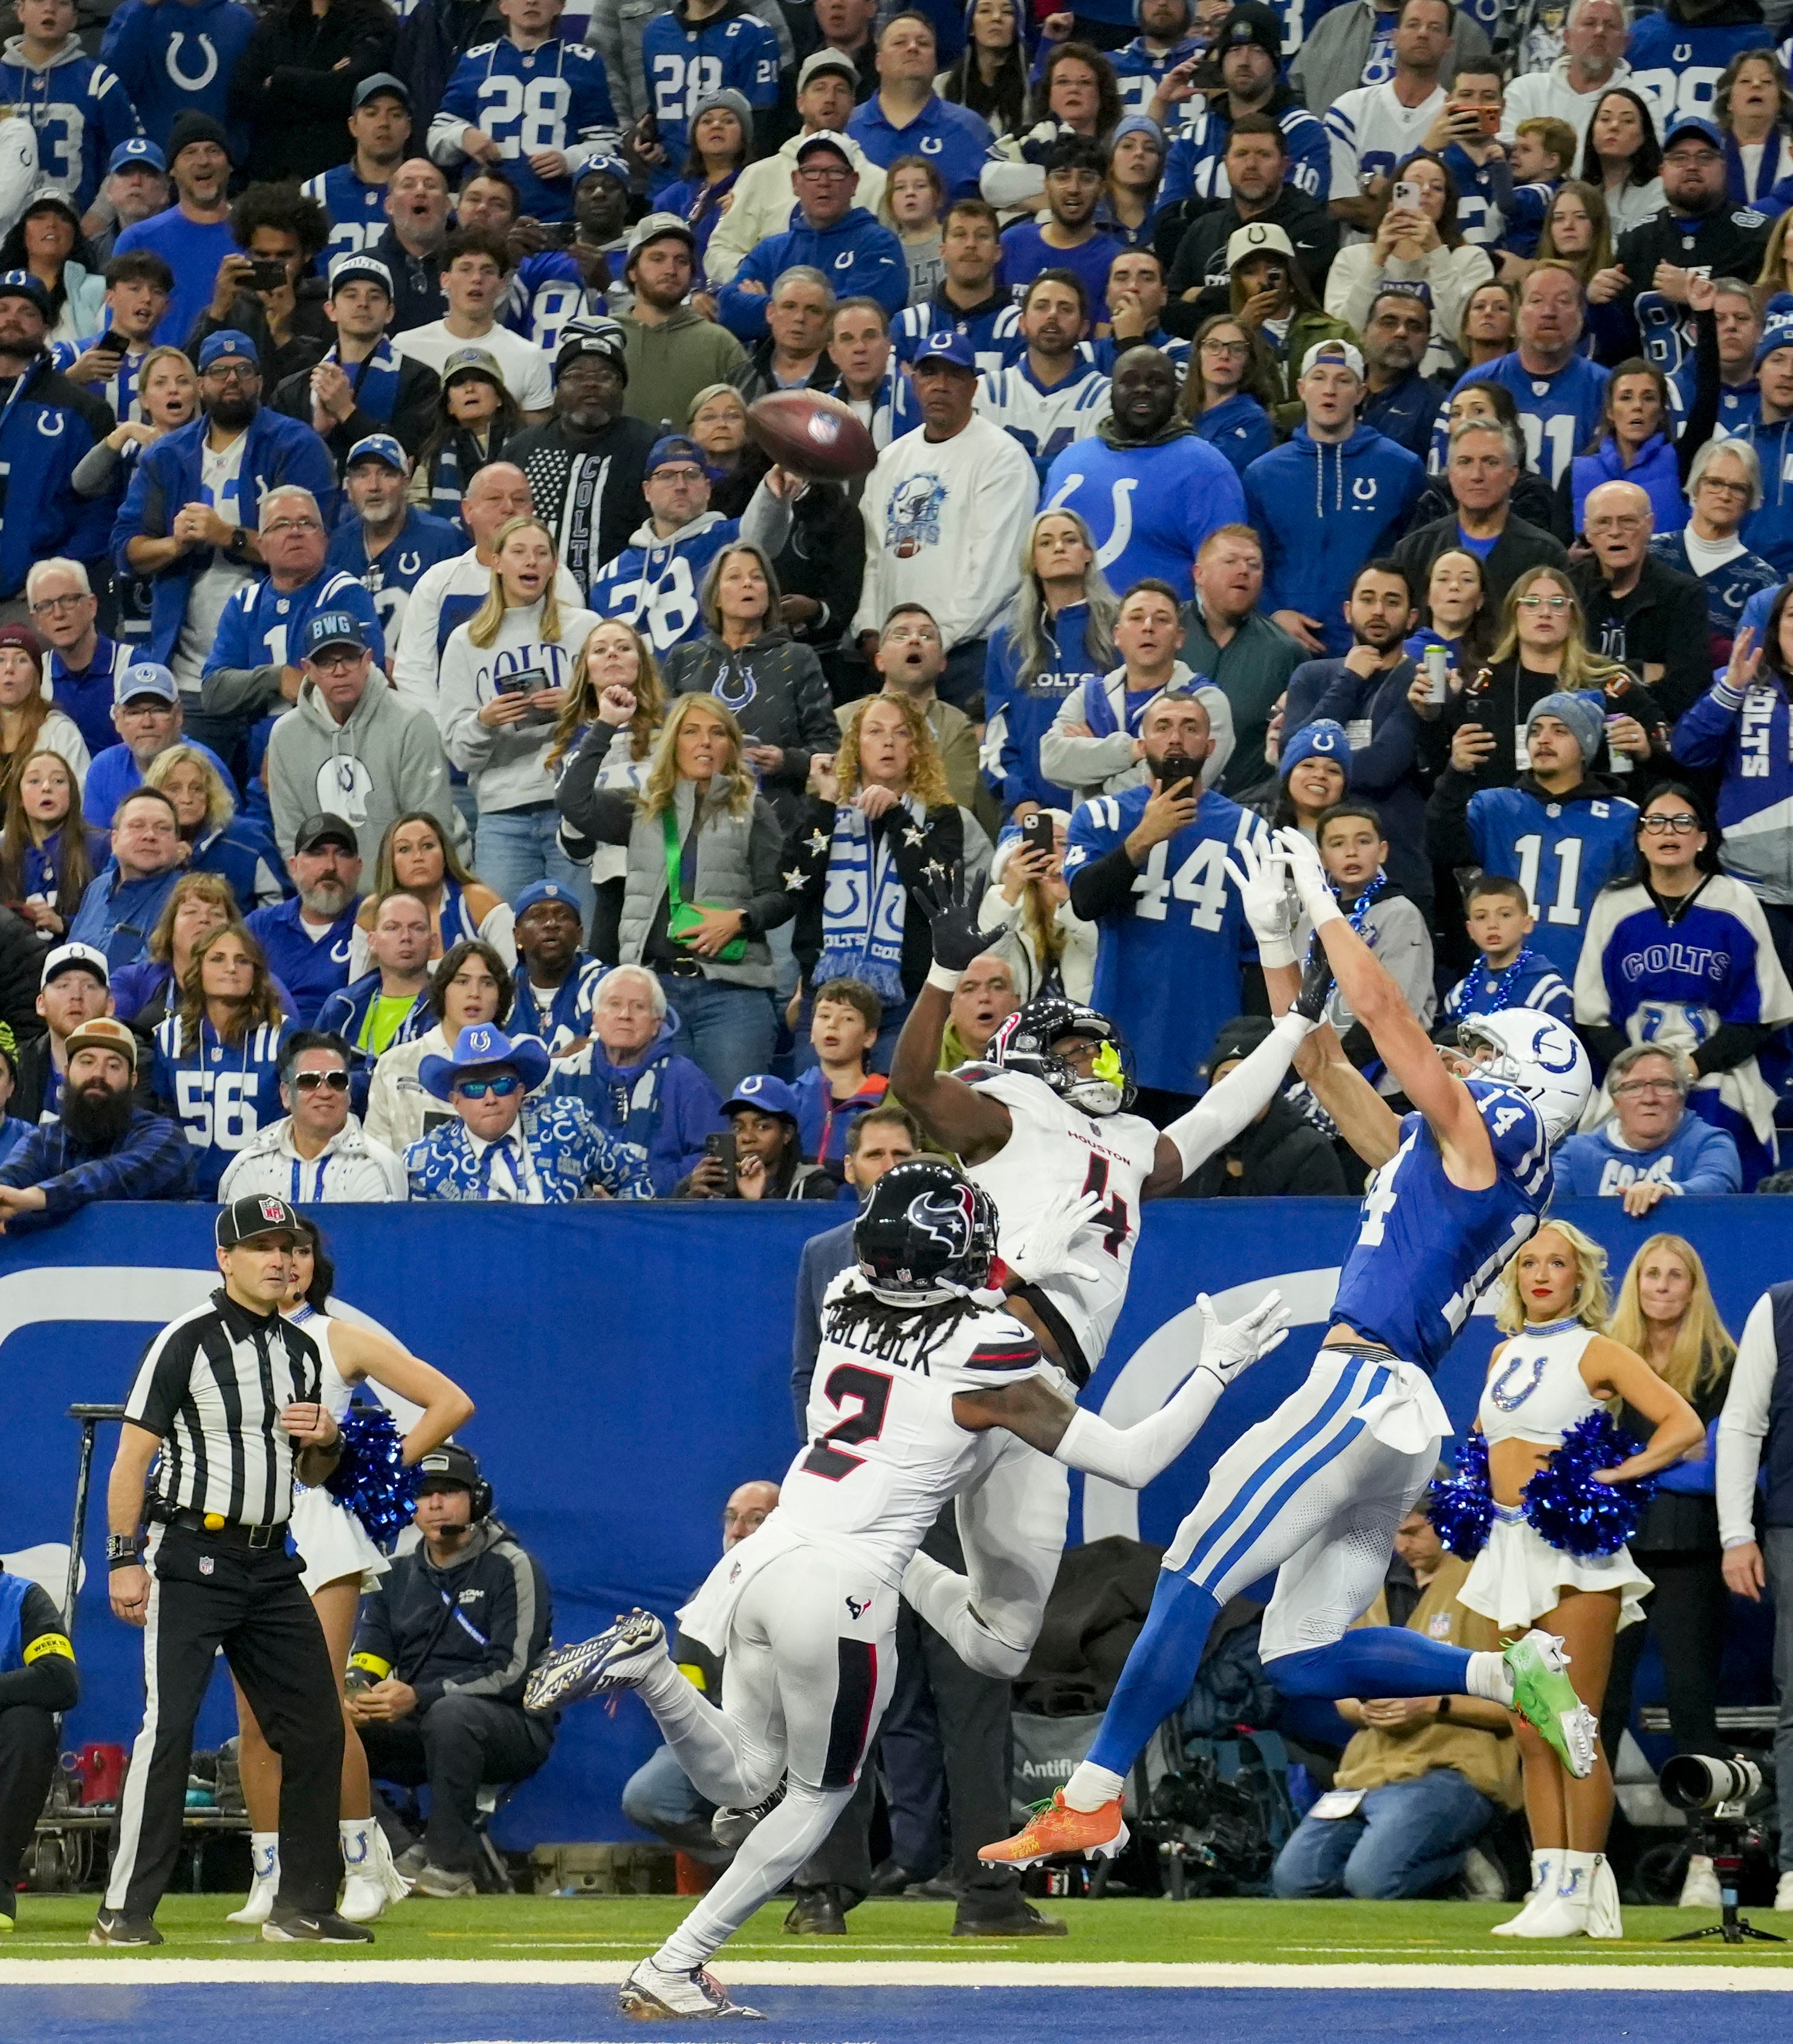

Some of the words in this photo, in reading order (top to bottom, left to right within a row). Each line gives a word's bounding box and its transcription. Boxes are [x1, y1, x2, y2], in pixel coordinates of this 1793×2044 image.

[725, 22, 742, 36] C
[479, 74, 571, 160] 28
[653, 54, 721, 120] 28
[8, 102, 84, 191] 3
[531, 279, 590, 352] 8
[1633, 291, 1696, 377] 8
[312, 615, 351, 640] BWG
[607, 557, 699, 652] 28
[1031, 673, 1095, 688] OLTS
[1590, 800, 1610, 819] C
[1131, 838, 1230, 933] 44
[1513, 833, 1581, 926] 11
[823, 932, 867, 949] OLTS
[871, 942, 903, 963] COL
[1621, 943, 1731, 982] COLTS
[175, 1070, 259, 1151] 56
[1476, 1087, 1526, 1137] 14
[1068, 1130, 1131, 1167] HOUSTON
[264, 1208, 284, 1220] NFL
[1080, 1150, 1133, 1260] 4
[1356, 1124, 1421, 1247] 4
[824, 1306, 945, 1377] ULLOCK
[799, 1362, 895, 1483] 2
[33, 1640, 56, 1652] WEEK
[1022, 1758, 1084, 1778] Antifir
